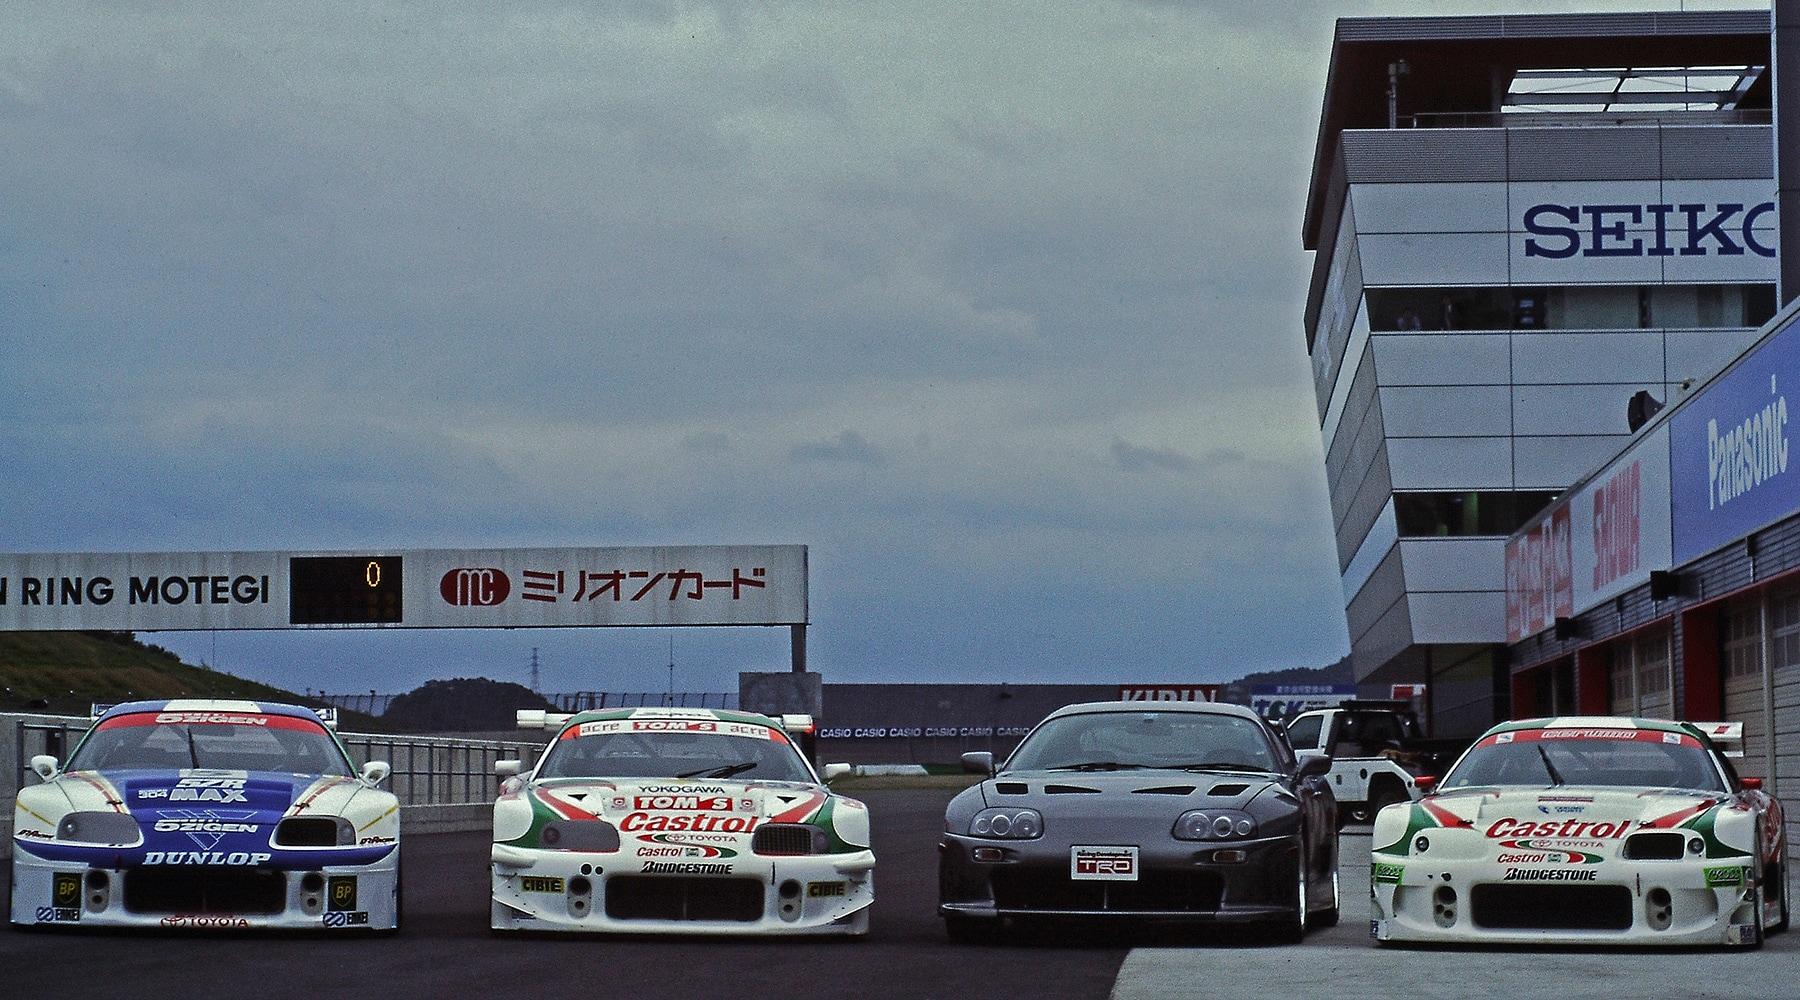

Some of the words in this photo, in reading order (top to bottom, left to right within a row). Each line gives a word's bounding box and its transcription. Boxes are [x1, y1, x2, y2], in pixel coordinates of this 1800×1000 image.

[1707, 372, 1789, 511] Panasonic
[21, 577, 114, 606] RING
[129, 575, 269, 605] MOTEGI
[521, 568, 766, 603] ミリオンカード
[820, 728, 851, 738] CASIO
[855, 728, 886, 738] CASIO
[889, 728, 922, 737] CASIO
[925, 727, 957, 737] CASIO
[960, 727, 993, 737] CASIO
[169, 788, 248, 804] MAX
[639, 786, 725, 794] YOKOGAWA
[154, 819, 259, 833] 5ZIGEN
[619, 812, 759, 834] Castrol
[1486, 817, 1632, 839] Castrol
[1556, 840, 1604, 848] TOYOTA
[142, 851, 272, 866] DUNLOP
[637, 847, 683, 857] Castrol
[1497, 853, 1546, 863] Castrol
[641, 861, 733, 875] BRIDGESTONE
[1079, 860, 1130, 874] TRD
[1504, 868, 1598, 881] BRIDGESTONE
[59, 882, 76, 895] BP
[335, 885, 352, 899] BP
[522, 878, 562, 893] CIBIE
[190, 917, 249, 928] TOYOTA
